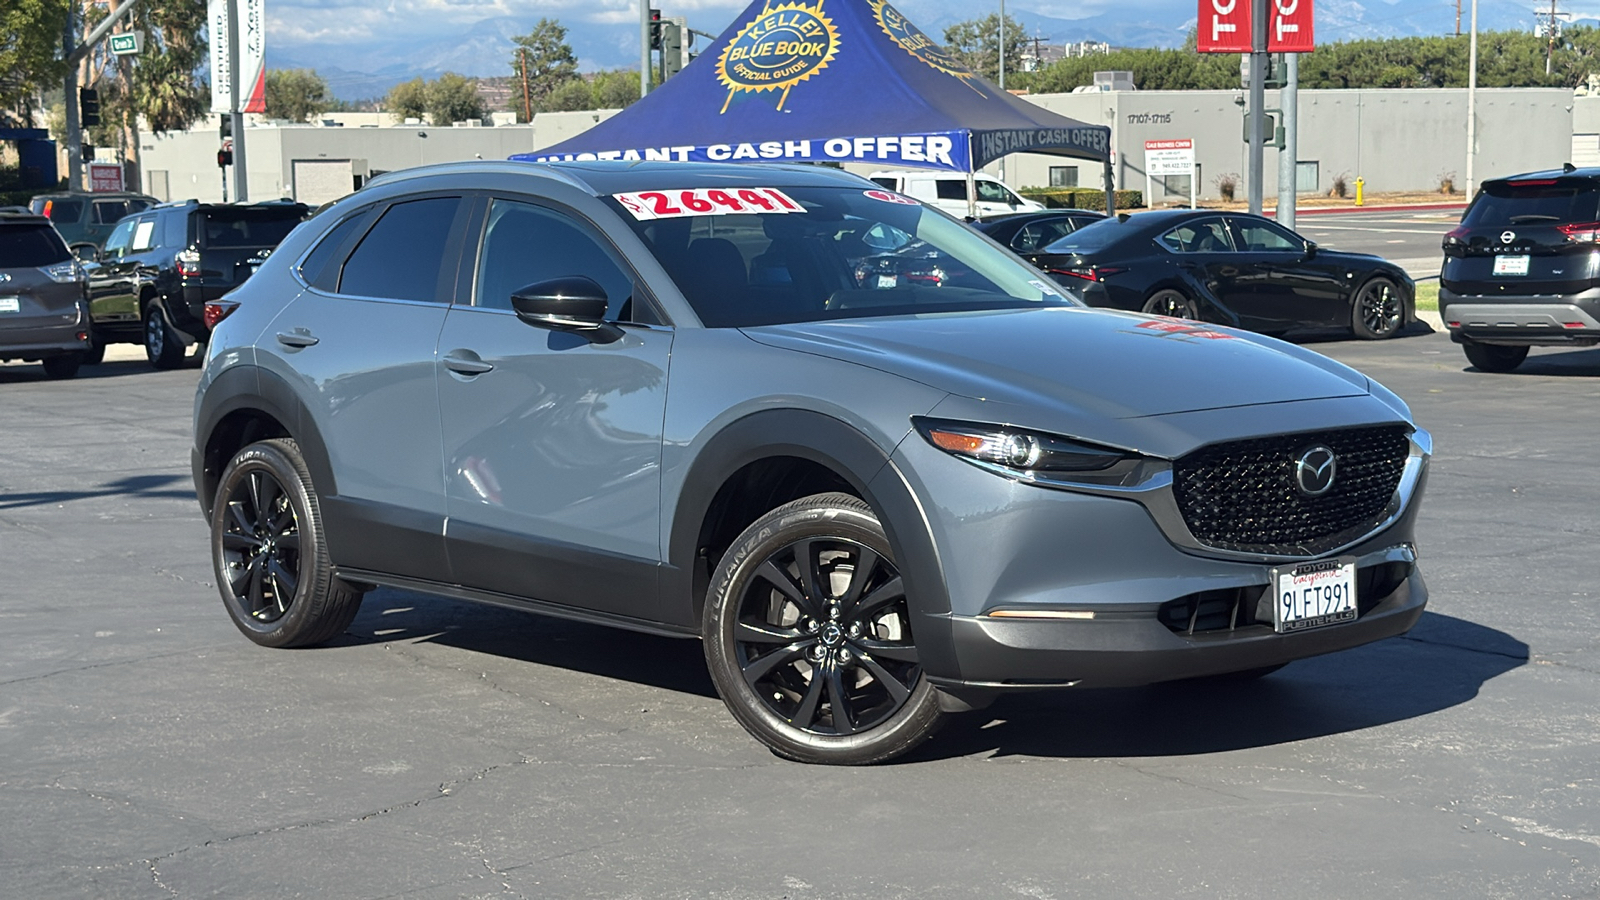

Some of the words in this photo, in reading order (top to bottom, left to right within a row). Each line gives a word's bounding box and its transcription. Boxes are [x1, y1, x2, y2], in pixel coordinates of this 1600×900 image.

[747, 13, 824, 40] KELLEY
[729, 42, 775, 61] BLUE
[774, 41, 826, 56] BOOK
[733, 63, 772, 80] OFFICIAL
[773, 60, 809, 79] GUIDE
[1127, 114, 1171, 124] 17107-17115
[706, 140, 811, 160] CASH
[823, 136, 953, 166] OFFER
[981, 131, 1035, 160] INSTANT
[1038, 129, 1069, 145] CASH
[1072, 129, 1108, 153] OFFER
[710, 527, 772, 622] TURANZA
[1296, 561, 1338, 573] TOYOTA
[1283, 582, 1351, 621] 9LFT991
[1283, 616, 1325, 631] PUENTE
[1325, 611, 1355, 622] HILLS
